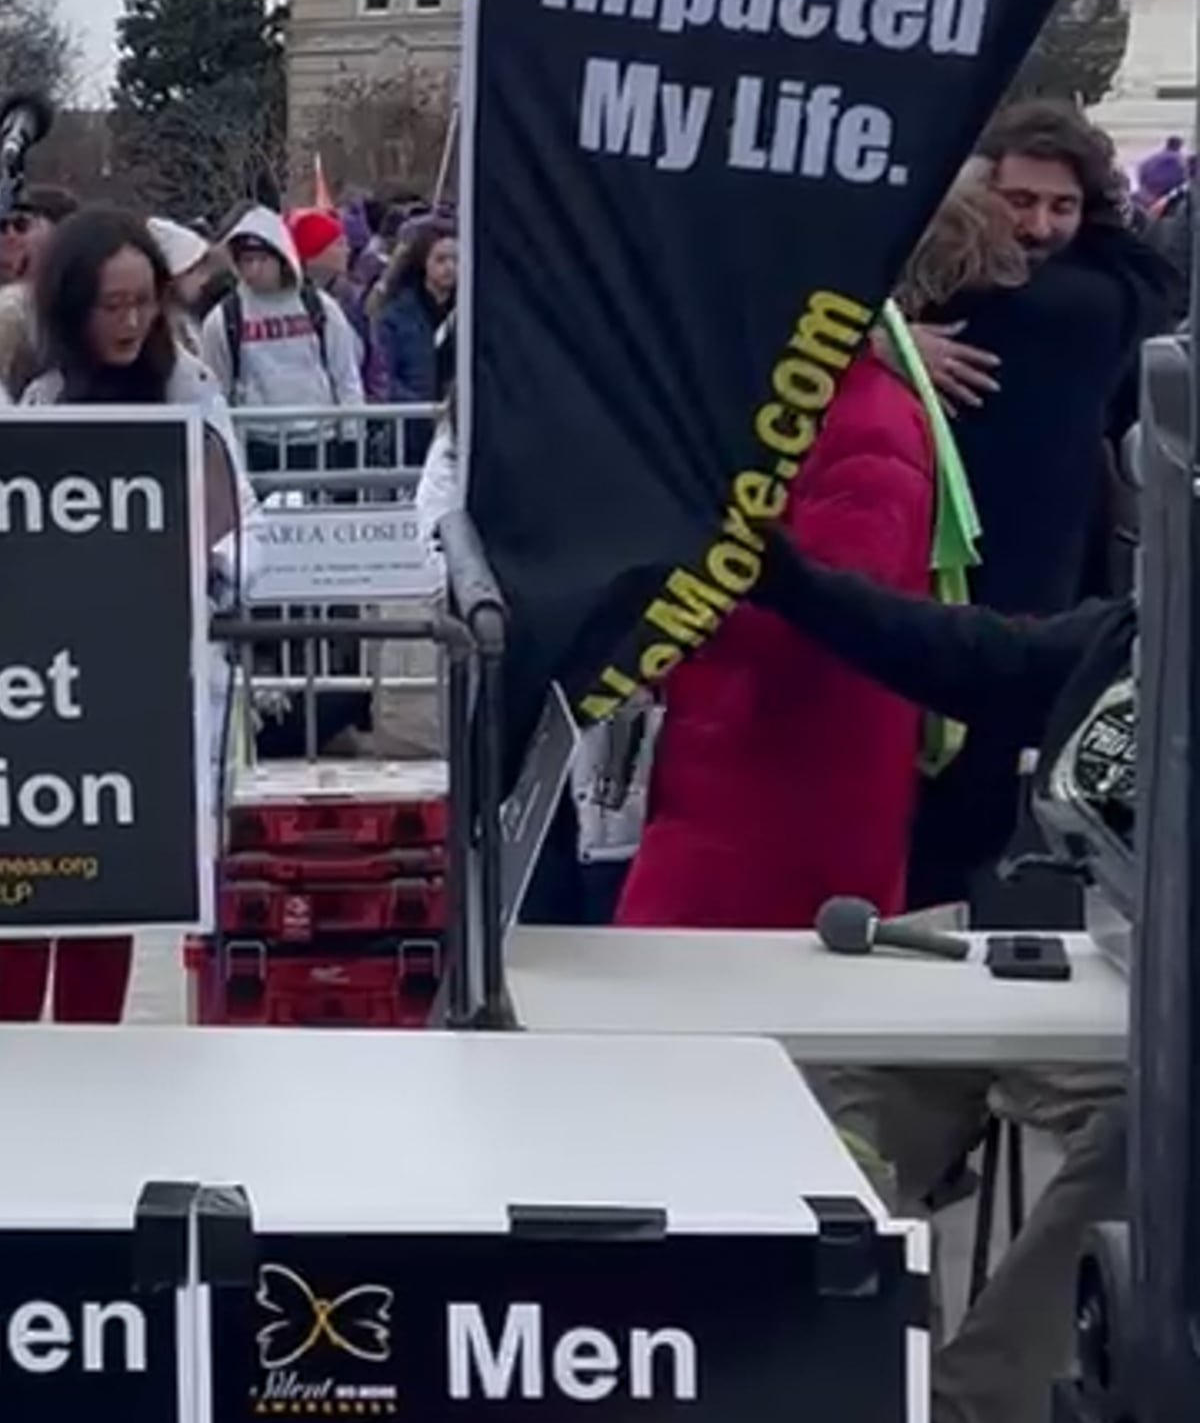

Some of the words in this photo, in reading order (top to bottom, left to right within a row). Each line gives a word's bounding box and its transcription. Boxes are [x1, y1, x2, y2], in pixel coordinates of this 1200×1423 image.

[579, 57, 712, 170] My
[727, 75, 908, 185] Life.
[265, 525, 325, 544] AREA
[333, 521, 418, 544] CLOSED
[447, 1302, 697, 1400] Men
